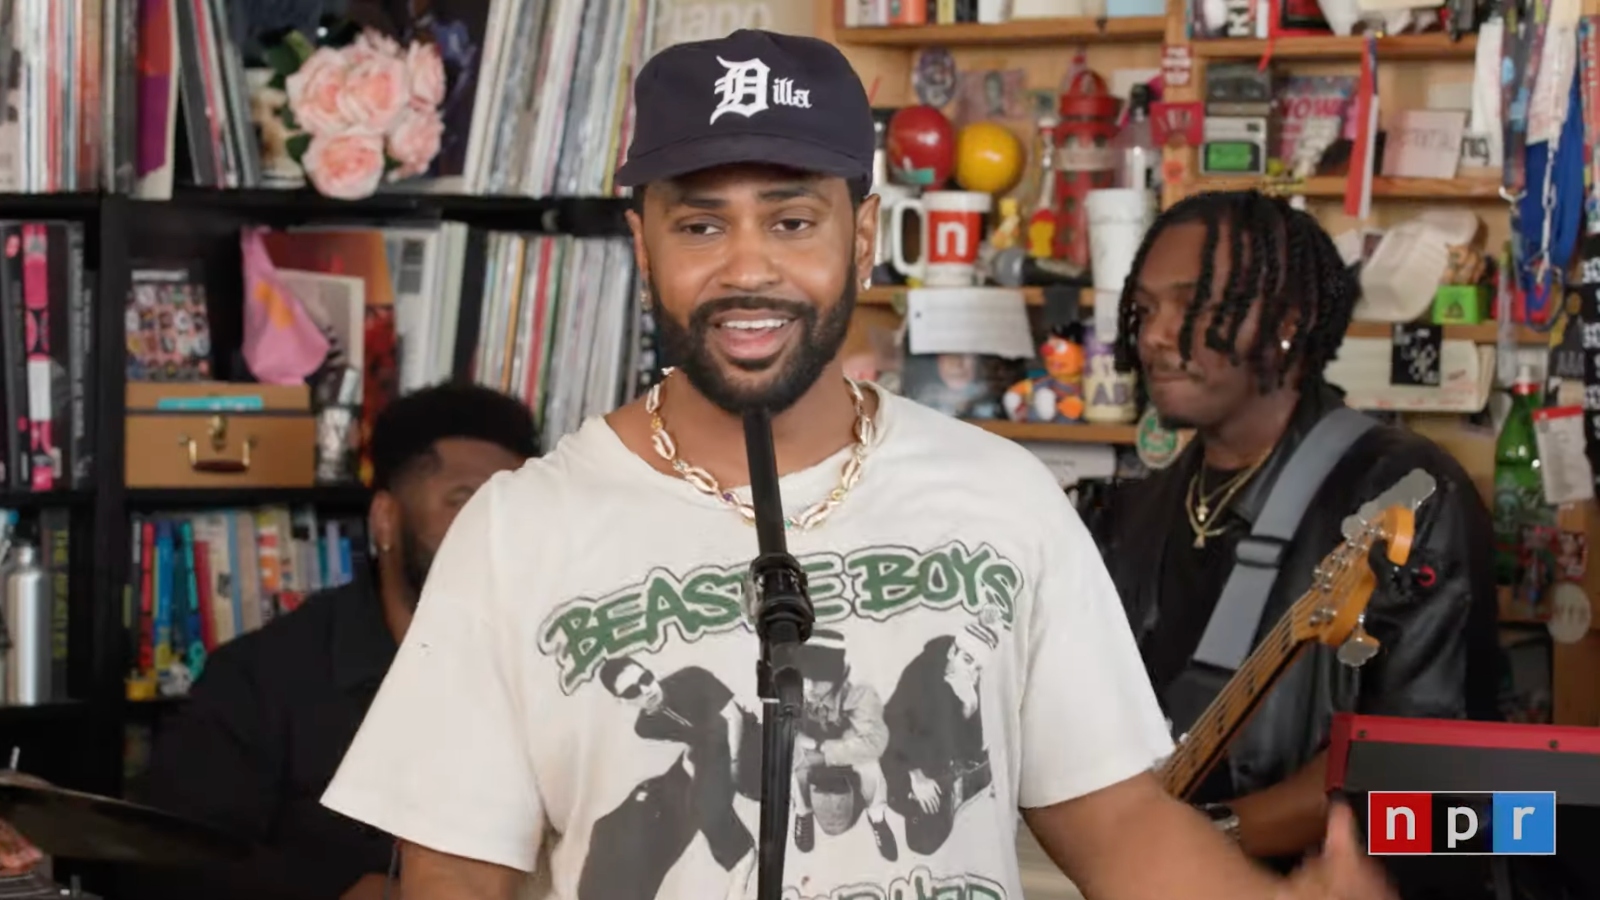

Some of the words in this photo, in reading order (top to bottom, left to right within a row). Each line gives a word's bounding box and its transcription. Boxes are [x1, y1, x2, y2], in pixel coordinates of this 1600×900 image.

[936, 221, 968, 257] n
[540, 552, 850, 690] BEASE
[847, 543, 1018, 626] BOYS
